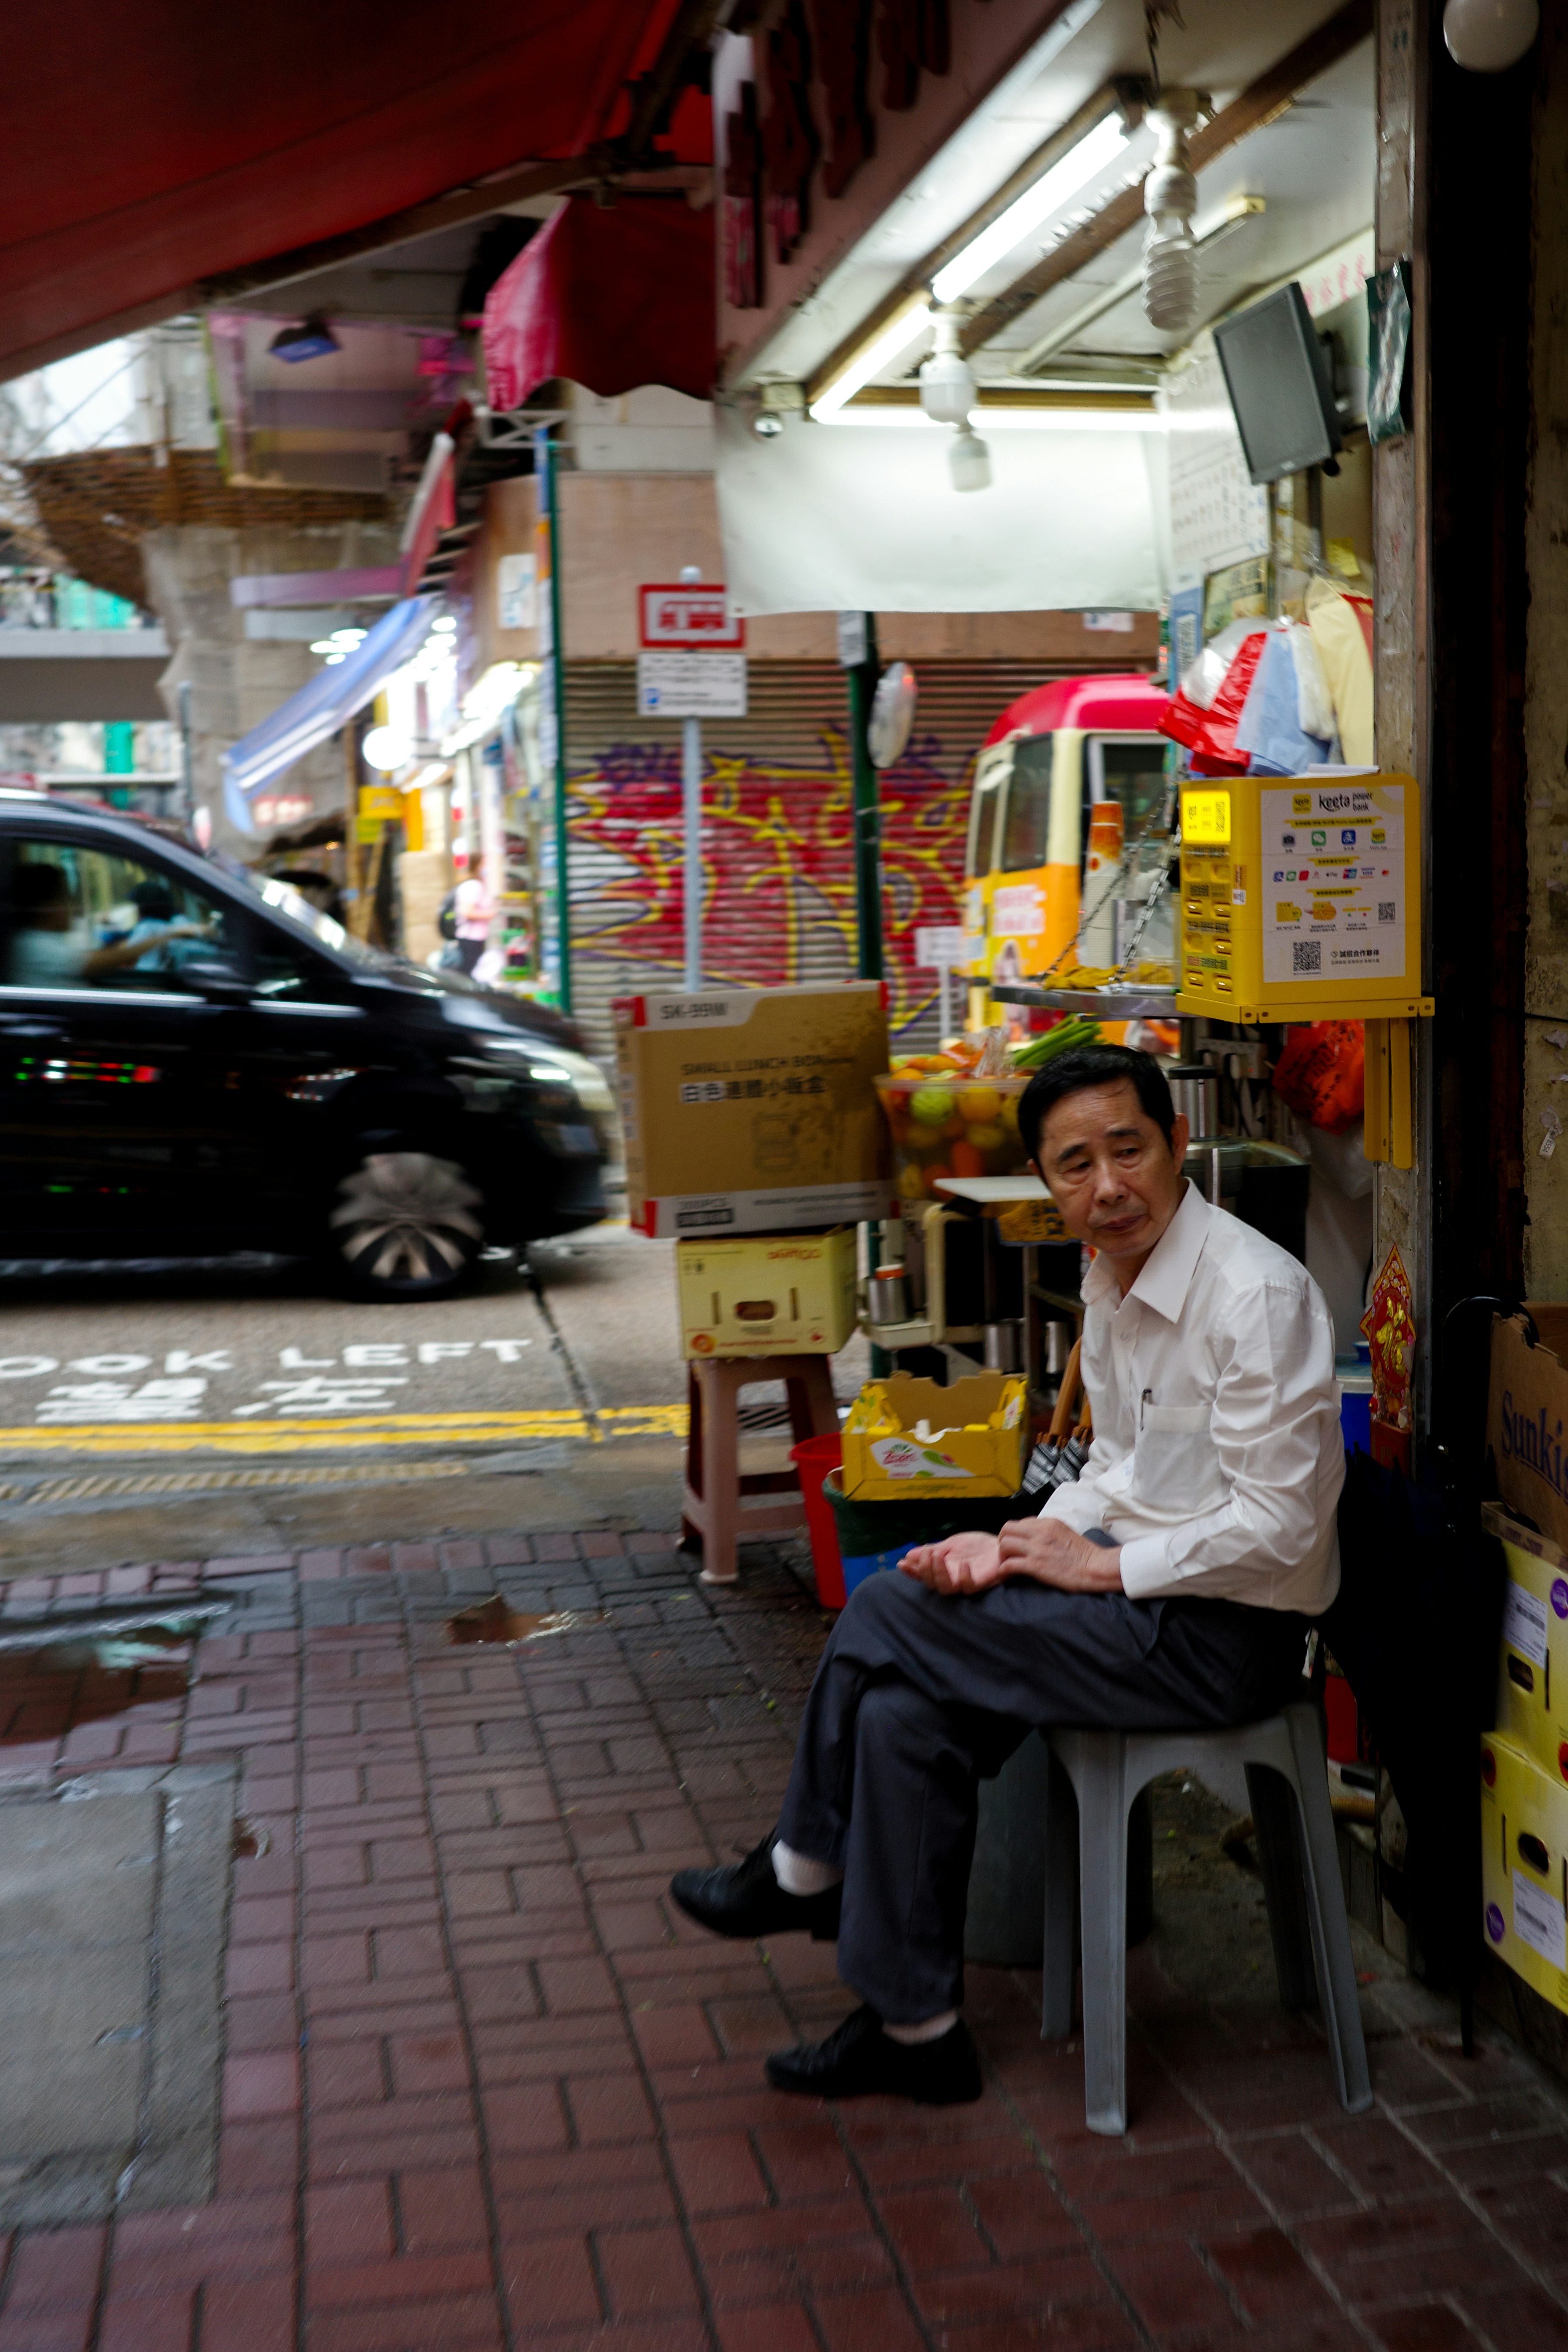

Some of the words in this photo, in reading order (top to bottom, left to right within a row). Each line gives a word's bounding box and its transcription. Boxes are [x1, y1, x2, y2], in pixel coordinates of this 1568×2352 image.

[1319, 793, 1350, 812] keeta
[1352, 792, 1373, 802] power
[1353, 802, 1370, 812] bank
[279, 1339, 533, 1368] LEFT
[35, 1377, 408, 1423] 望左
[1502, 1390, 1568, 1498] Sunki
